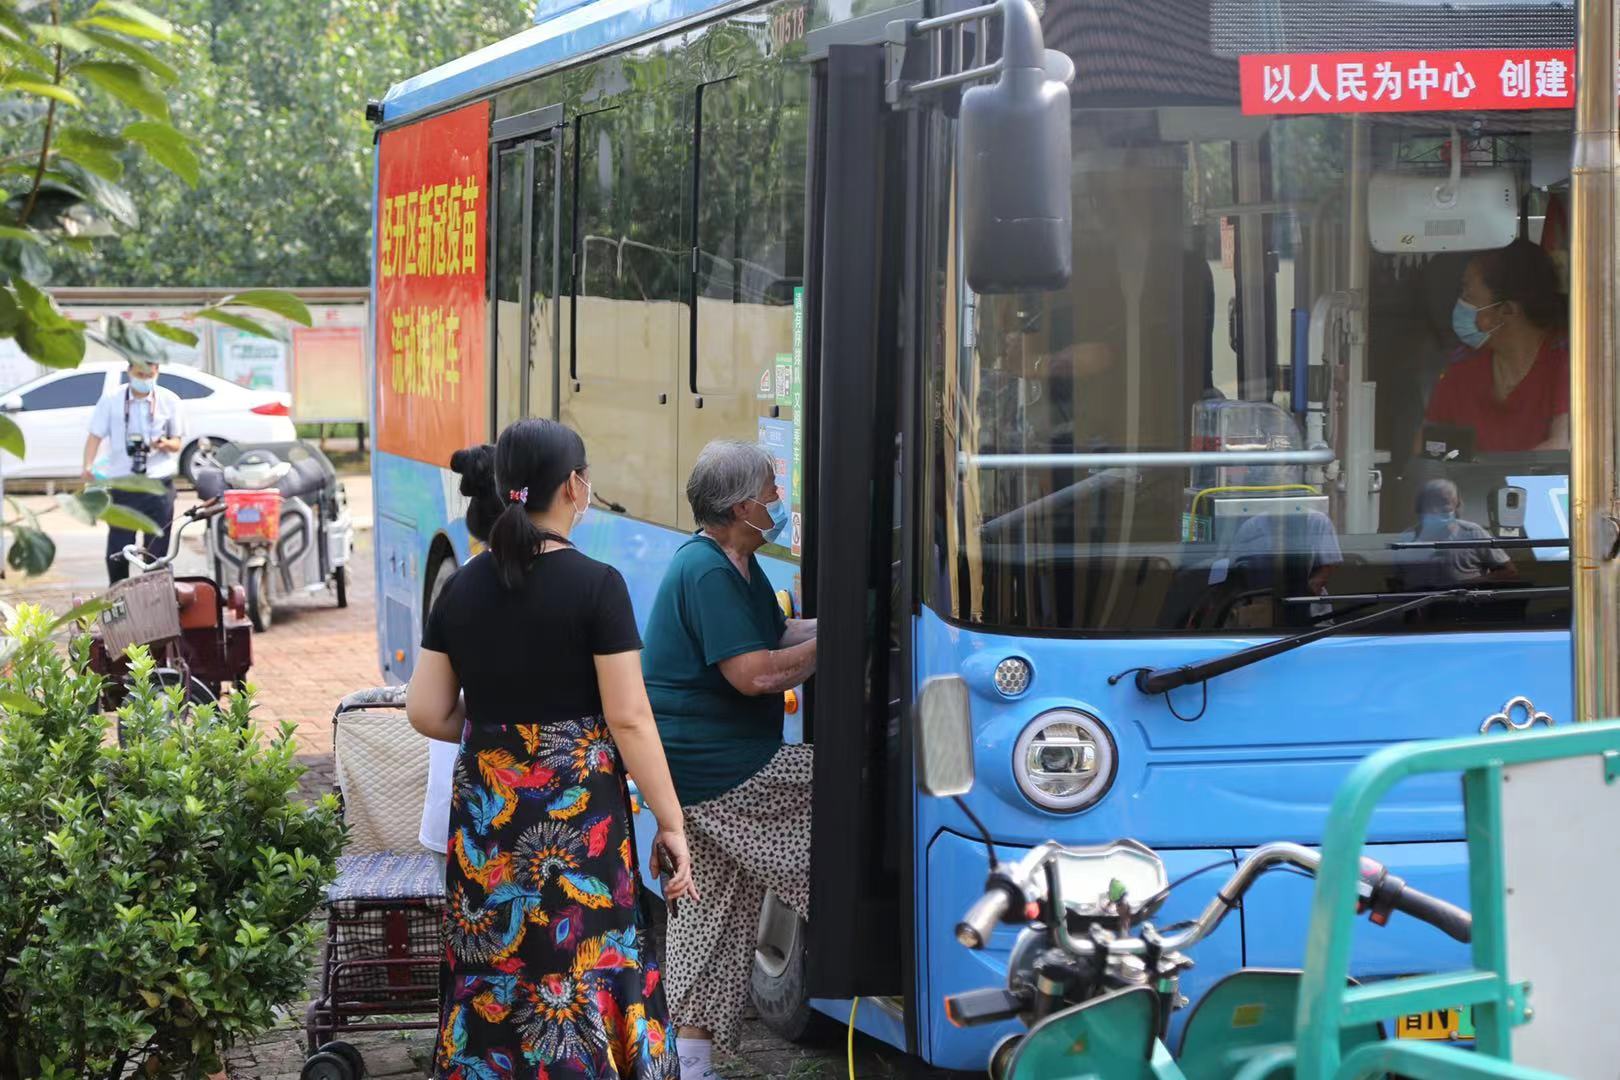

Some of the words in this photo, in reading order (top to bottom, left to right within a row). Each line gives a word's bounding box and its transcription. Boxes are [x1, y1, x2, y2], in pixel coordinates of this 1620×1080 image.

[1262, 59, 1477, 104] 以人民为中心
[1498, 58, 1576, 99] 创建
[381, 175, 480, 278] 经开区新冠疫苗
[391, 304, 462, 402] 流动接种车
